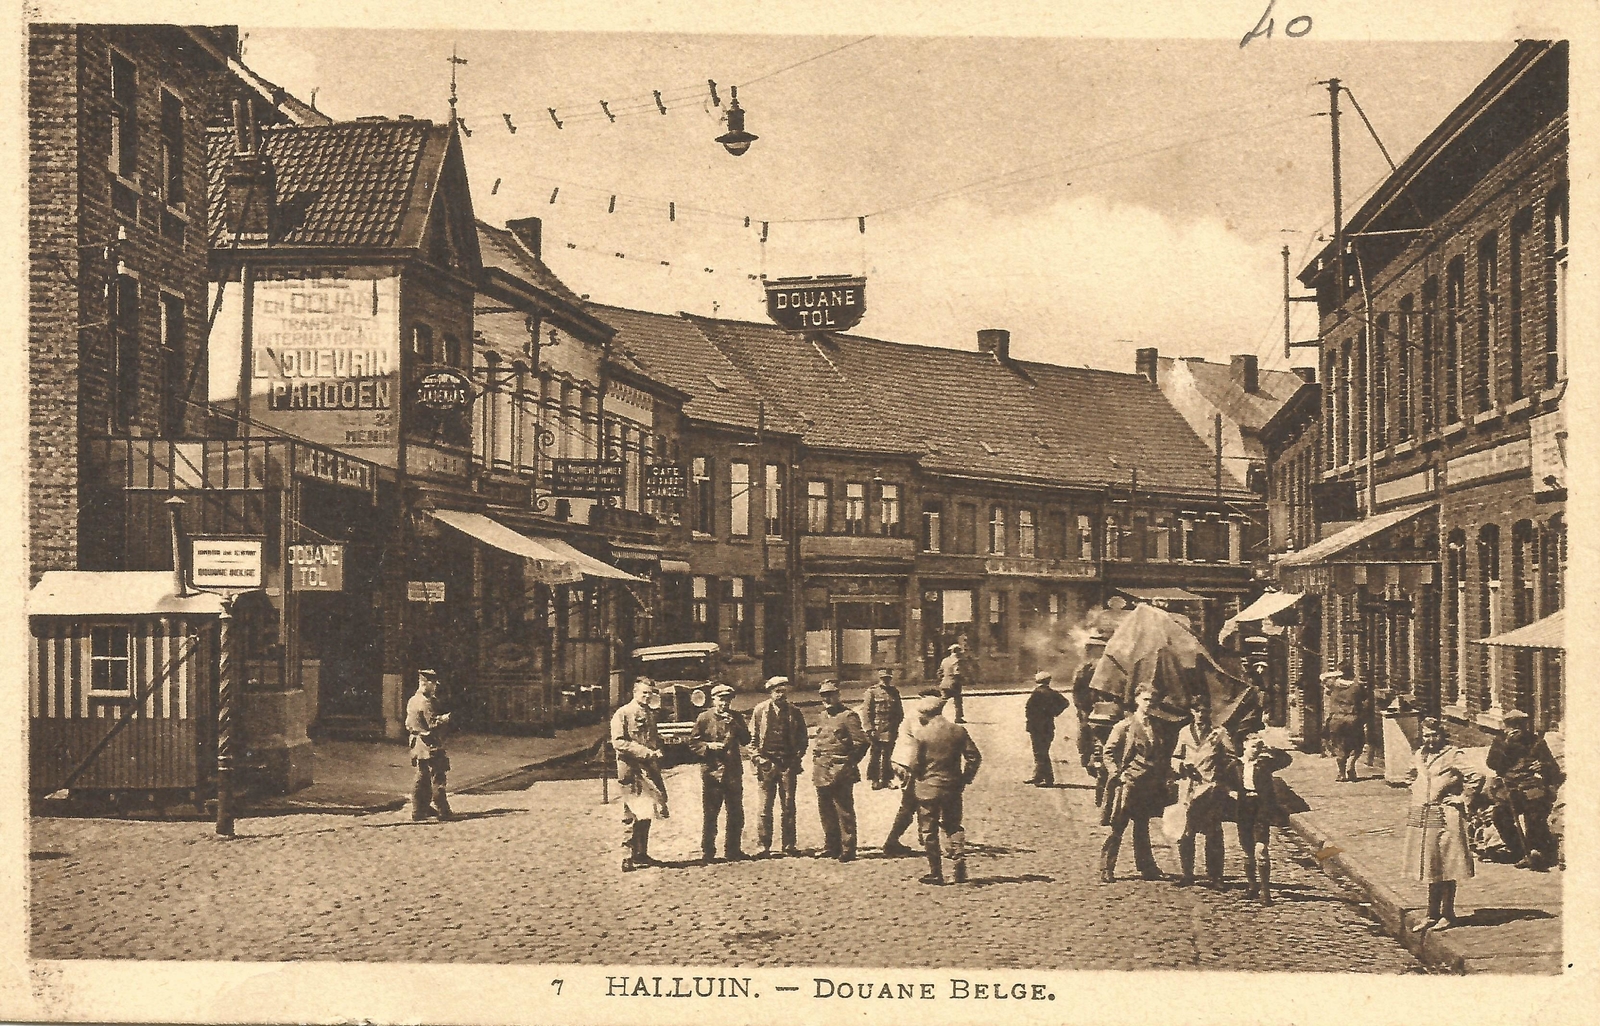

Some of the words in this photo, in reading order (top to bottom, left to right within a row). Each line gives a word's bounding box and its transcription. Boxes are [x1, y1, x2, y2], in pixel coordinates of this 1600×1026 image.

[1239, 0, 1313, 49] 40
[776, 290, 855, 310] DOUANE
[799, 309, 835, 327] TOL
[272, 381, 391, 408] PARDOEN
[288, 545, 339, 564] DOUANE
[300, 567, 328, 586] TOL
